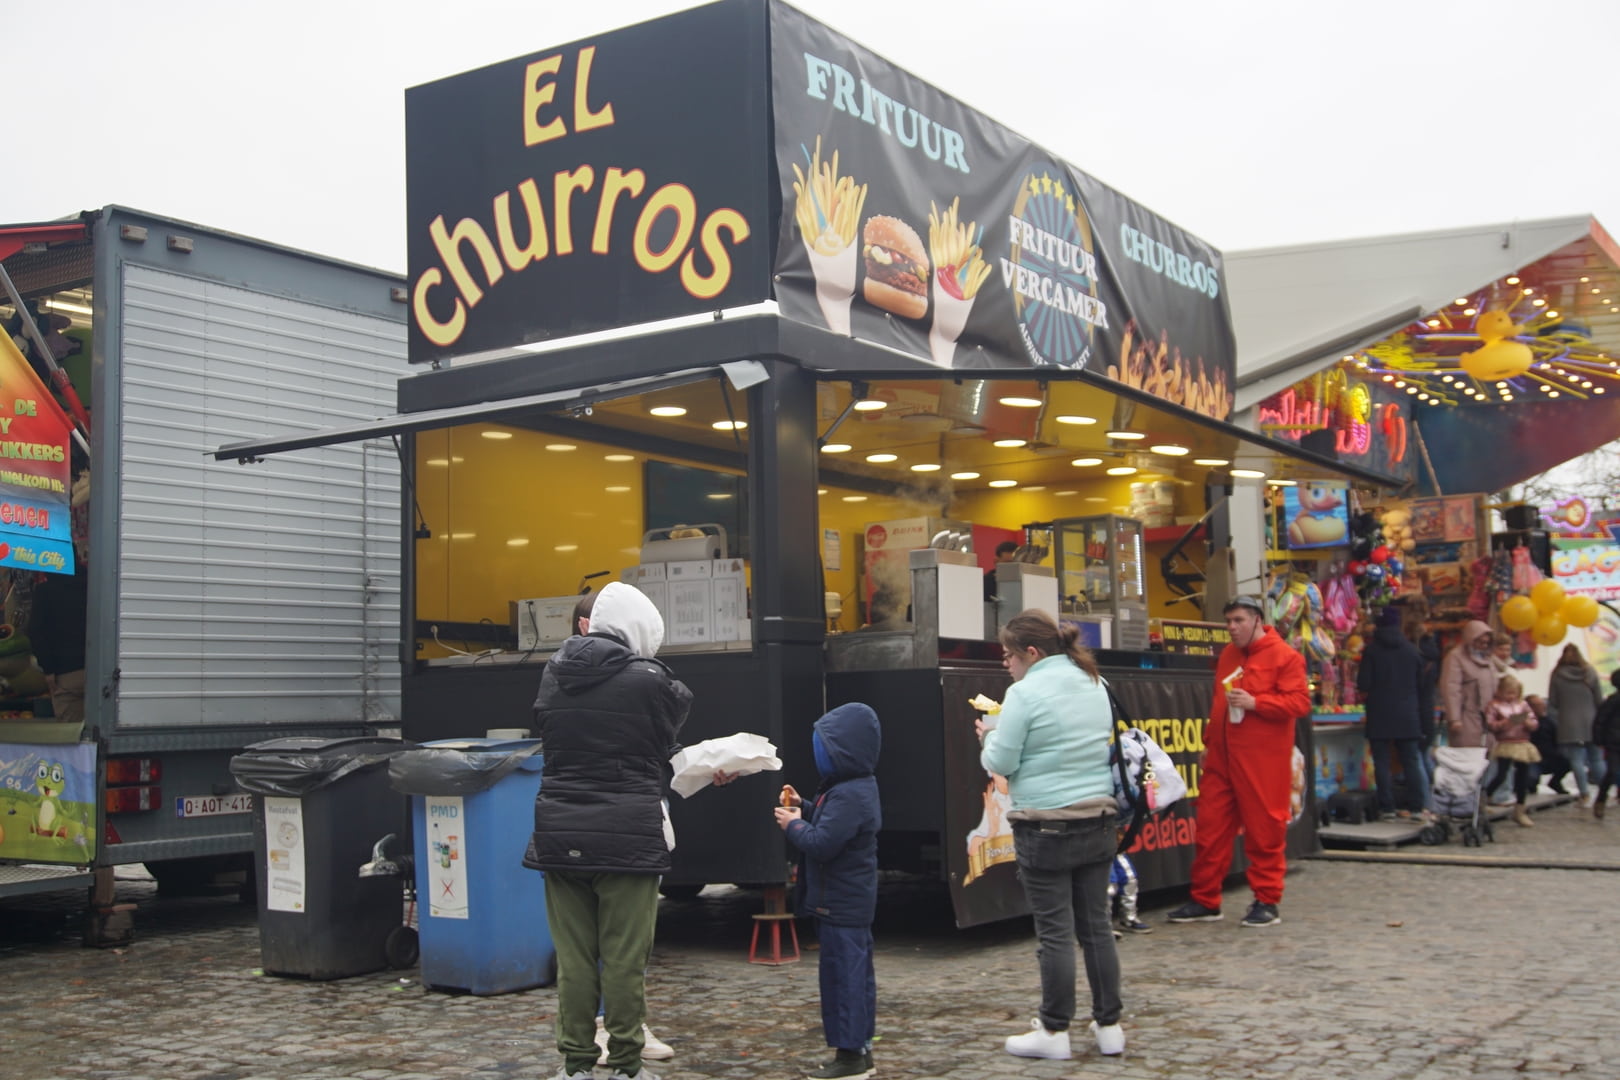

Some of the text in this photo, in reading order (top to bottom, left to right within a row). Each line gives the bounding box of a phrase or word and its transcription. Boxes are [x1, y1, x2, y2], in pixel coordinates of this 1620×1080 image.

[523, 45, 615, 147] EL
[804, 52, 970, 174] FRITUUR
[413, 164, 751, 346] churros
[1008, 214, 1099, 283] FRITUUR
[1120, 222, 1219, 299] CHURROS
[1000, 257, 1110, 330] VERCAMER
[14, 398, 37, 417] DE
[430, 804, 458, 819] PMD
[1124, 812, 1197, 854] elgian
